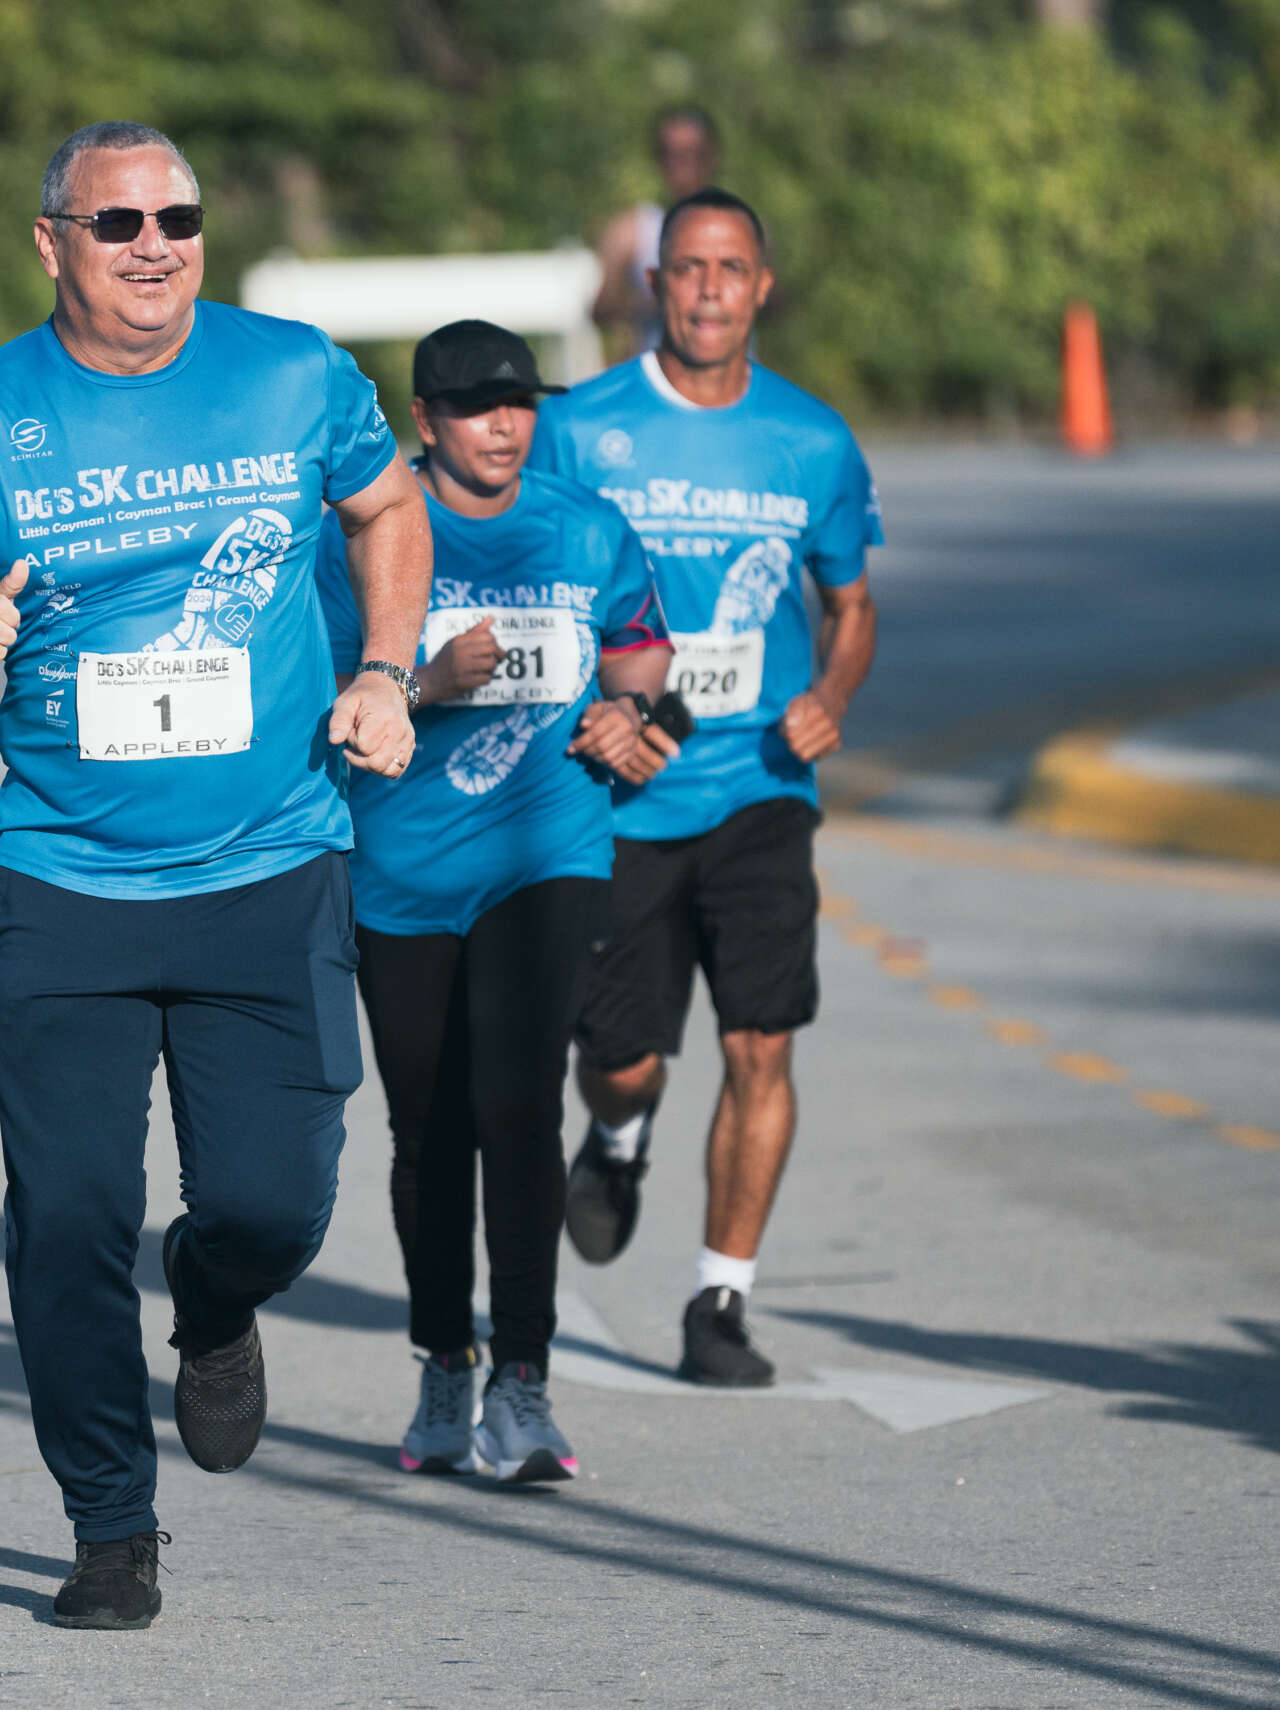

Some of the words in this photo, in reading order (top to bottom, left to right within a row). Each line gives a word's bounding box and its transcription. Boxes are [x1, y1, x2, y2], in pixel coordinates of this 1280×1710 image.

[10, 451, 53, 462] SCIMITAR
[77, 465, 133, 508] 5K
[135, 451, 299, 501] CHALLENGE
[18, 525, 50, 539] Little
[52, 516, 105, 533] Cayman
[115, 504, 172, 521] Cayman
[174, 499, 206, 512] Brac
[216, 493, 257, 507] Grand
[259, 491, 301, 505] Cayman
[24, 522, 198, 568] APPLEBY
[192, 571, 271, 612] CHALLENGE
[435, 576, 479, 607] 5K
[126, 656, 151, 676] 5K
[152, 656, 230, 676] CHALLENGE
[491, 646, 544, 680] 81
[46, 699, 62, 716] EY
[153, 694, 172, 732] 1
[104, 738, 228, 756] APPLEBY
